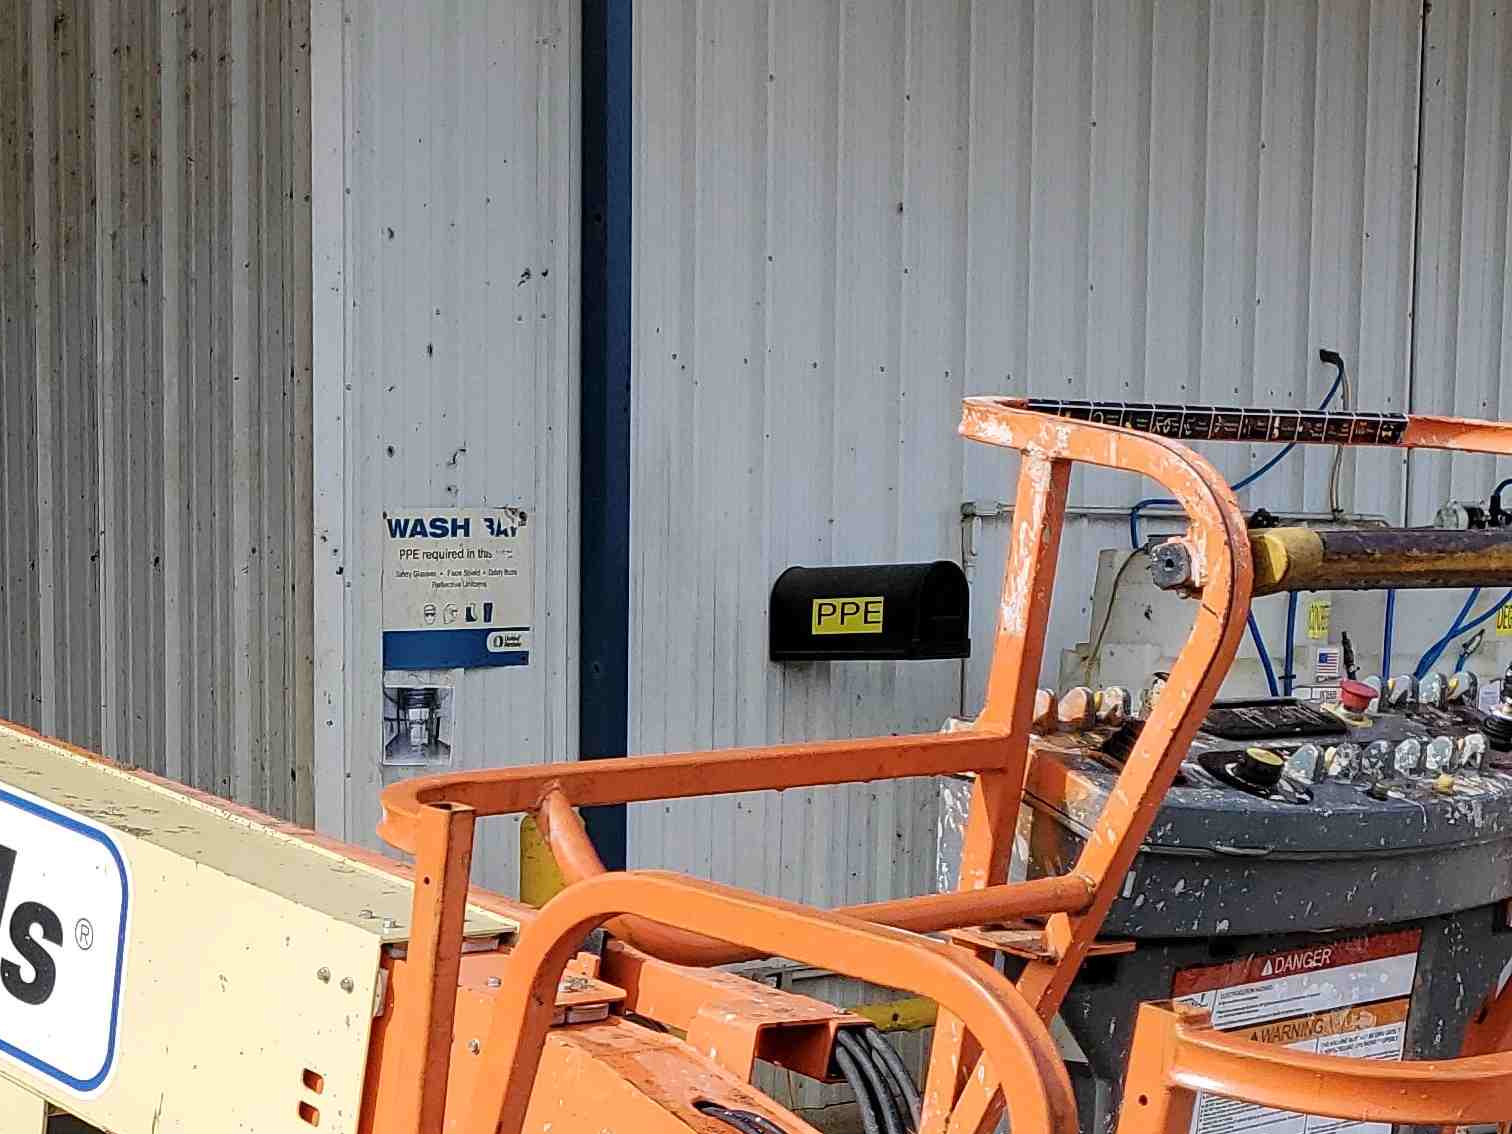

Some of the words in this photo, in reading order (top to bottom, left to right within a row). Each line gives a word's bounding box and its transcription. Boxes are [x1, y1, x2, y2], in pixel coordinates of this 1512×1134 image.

[387, 517, 471, 538] WASH
[399, 549, 419, 560] PPE
[422, 548, 464, 561] required
[467, 549, 475, 559] in
[817, 601, 882, 625] PPE
[1274, 949, 1332, 974] DANGER
[1260, 1018, 1324, 1043] WARNING
